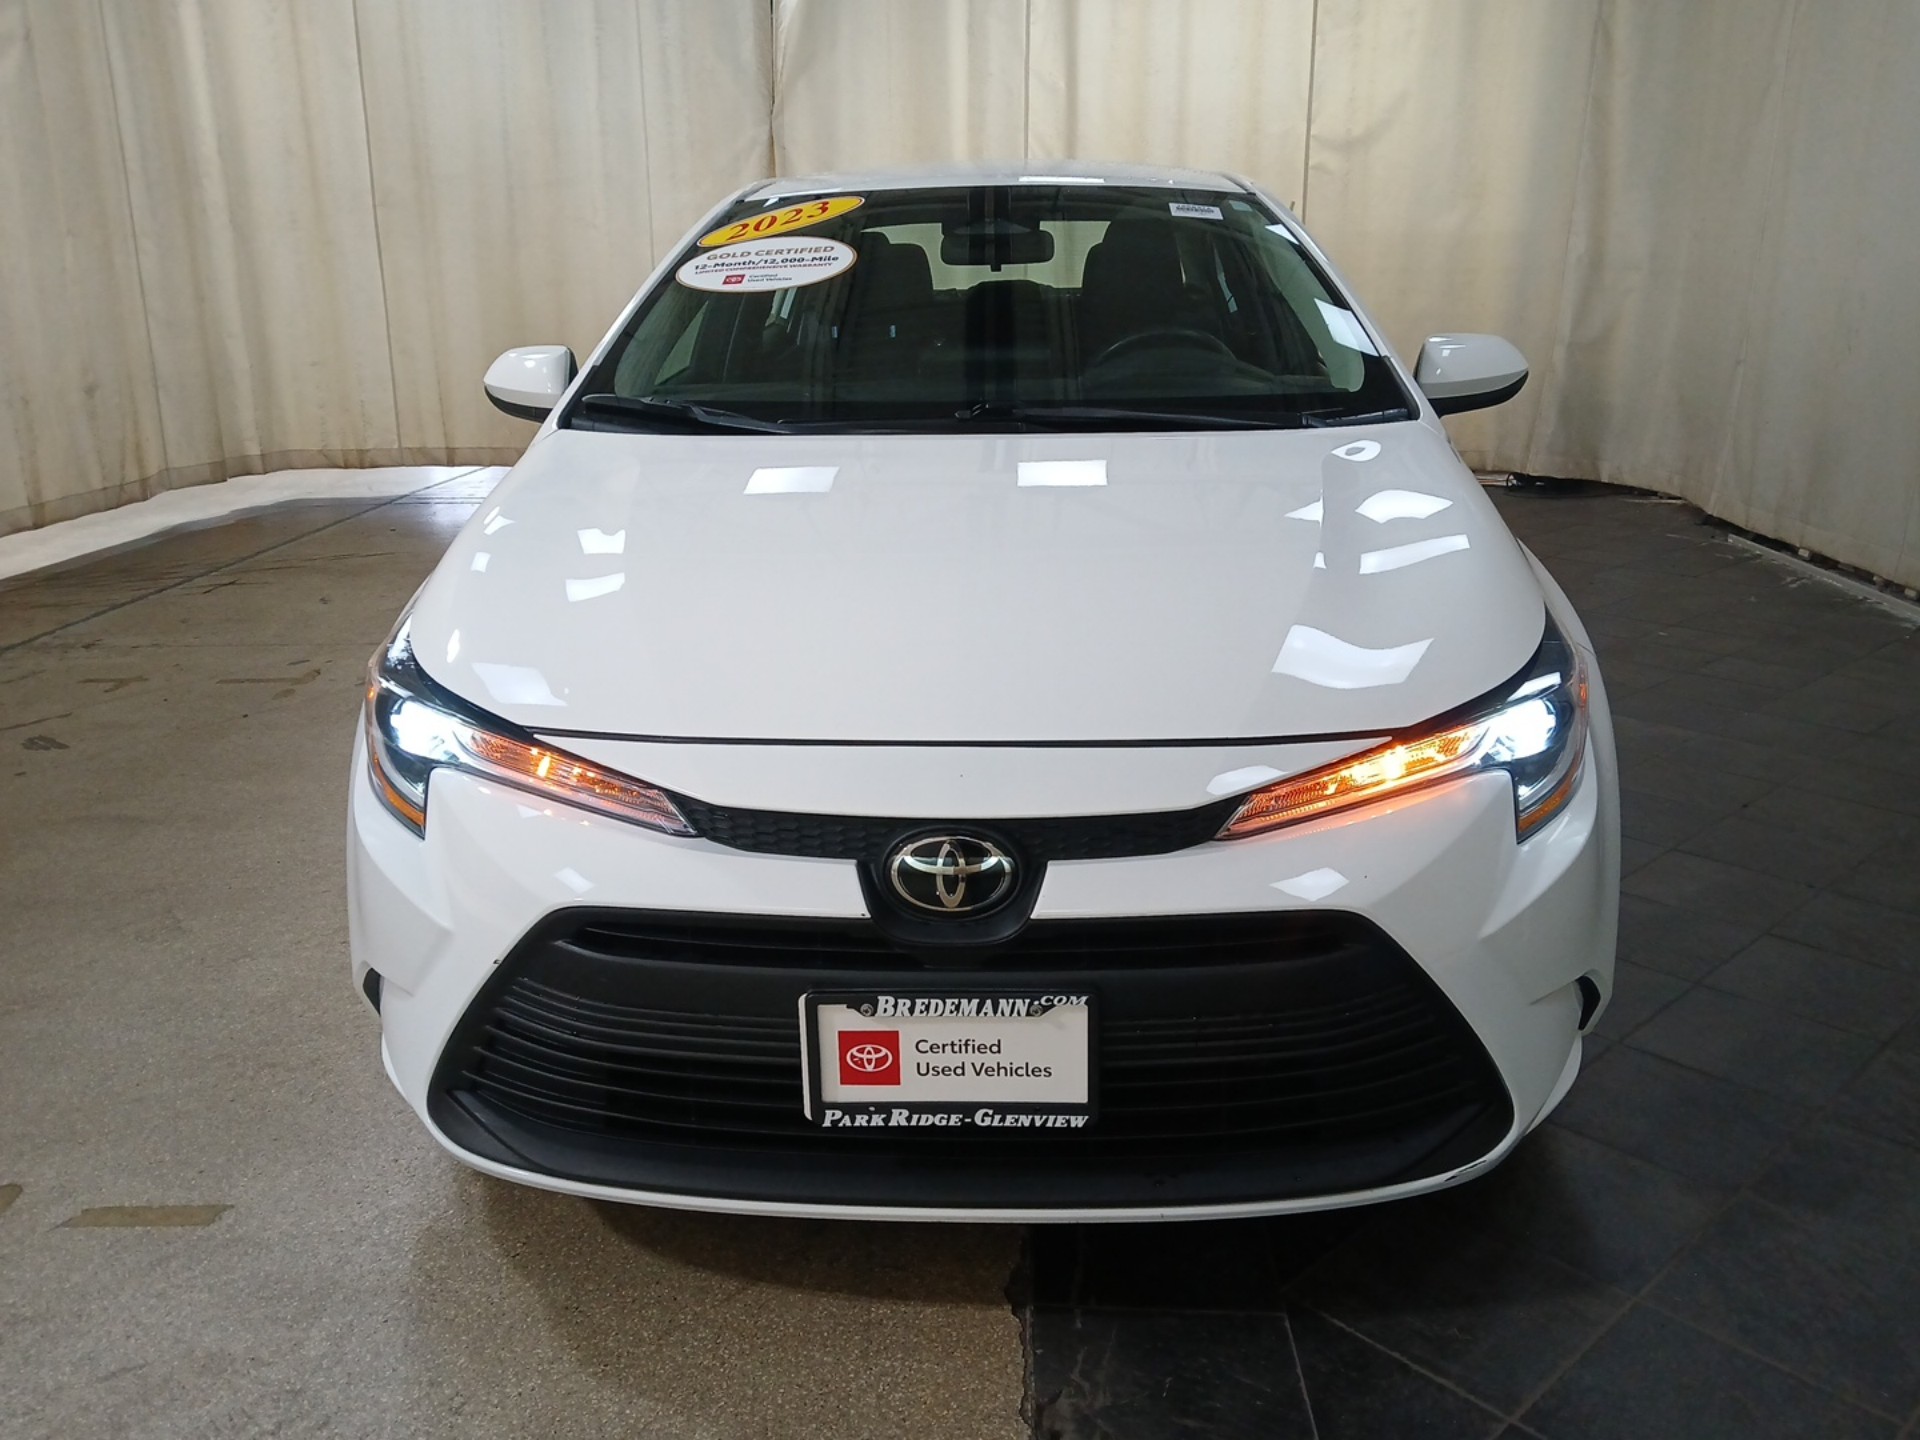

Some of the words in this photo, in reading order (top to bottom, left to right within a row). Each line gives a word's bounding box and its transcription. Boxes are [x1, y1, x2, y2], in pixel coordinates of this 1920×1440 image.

[725, 200, 830, 242] 2023
[706, 251, 752, 261] GOLD
[754, 245, 835, 257] CERTIFIED
[695, 256, 840, 270] 12-Month/12,000-Mile
[915, 1039, 1002, 1055] Certified
[916, 1062, 966, 1077] Used
[970, 1062, 1053, 1078] Vehicles
[822, 1109, 888, 1127] PARK
